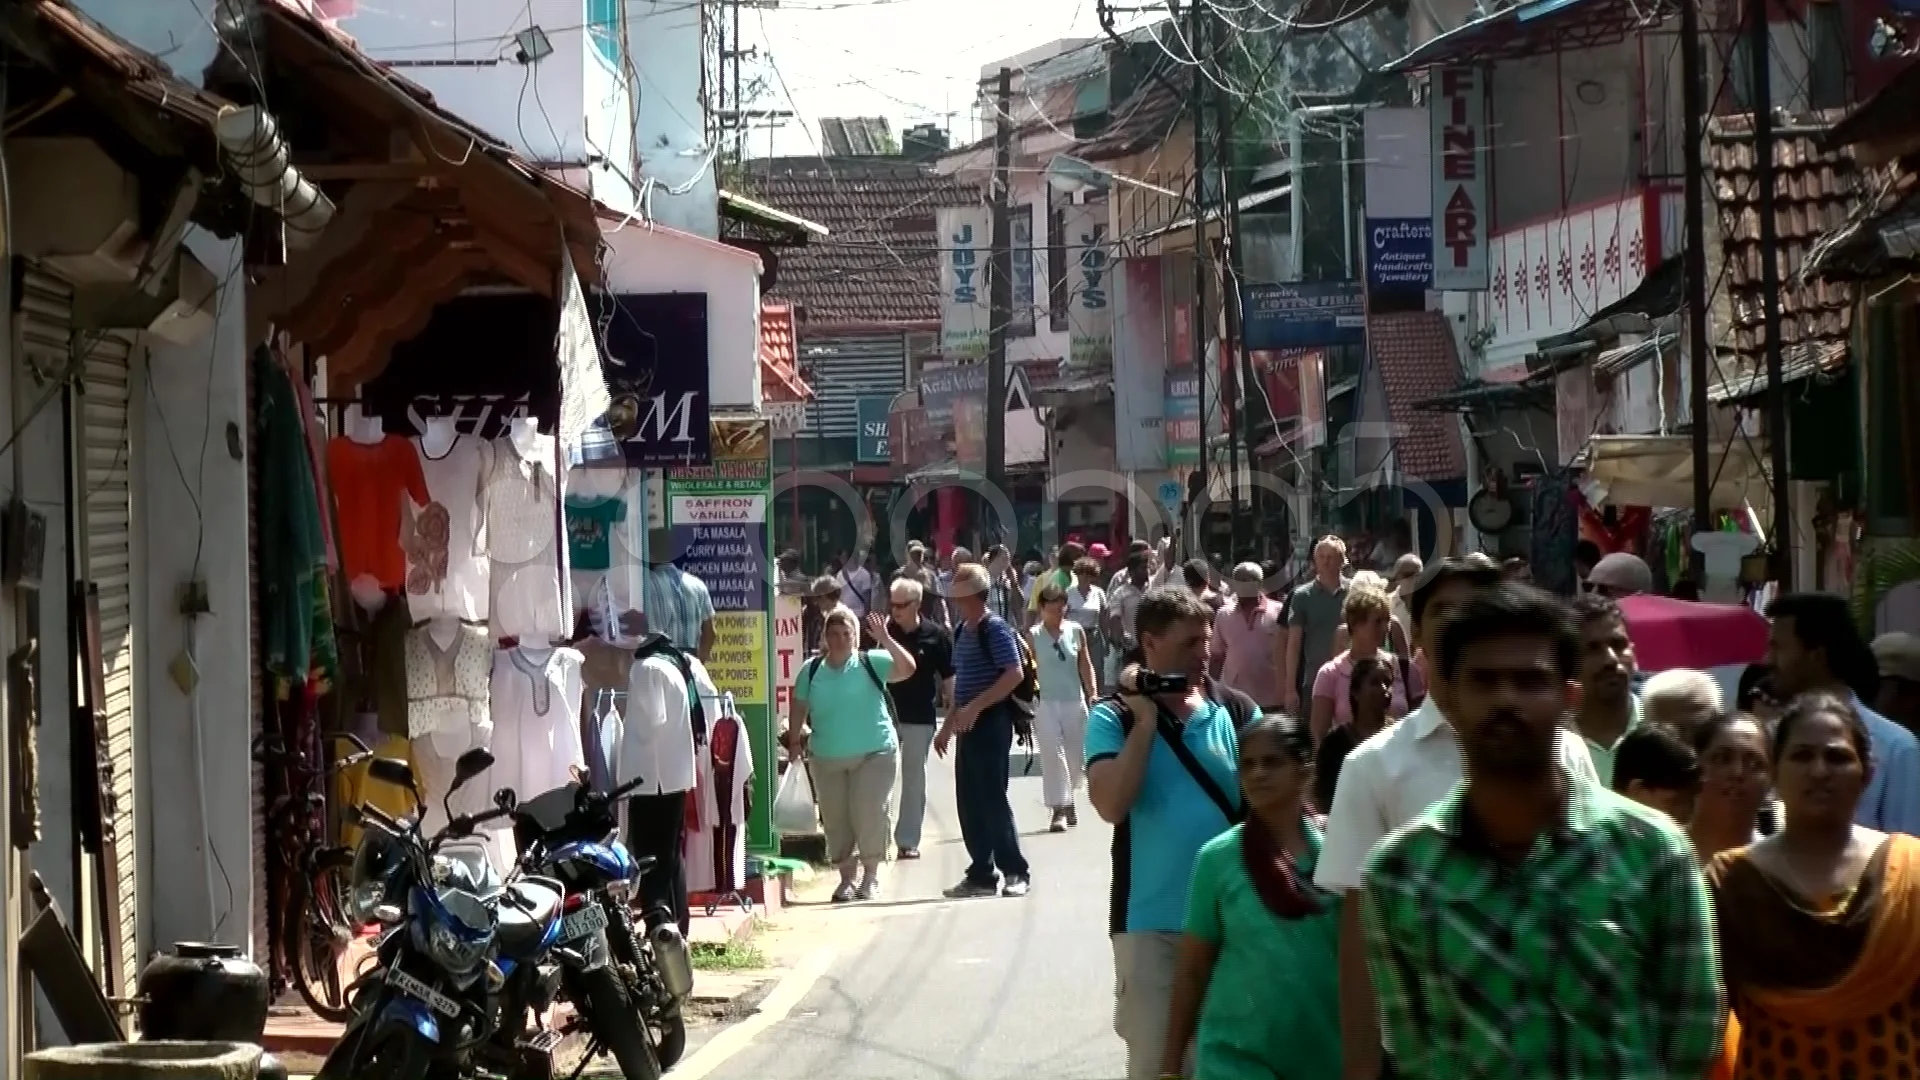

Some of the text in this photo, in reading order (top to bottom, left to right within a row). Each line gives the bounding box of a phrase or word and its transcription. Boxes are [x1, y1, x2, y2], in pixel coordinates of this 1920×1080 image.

[1443, 68, 1476, 181] FINE
[1445, 184, 1477, 267] ART
[1374, 222, 1432, 248] Crafters
[1381, 252, 1426, 261] Antiques
[952, 224, 977, 303] JOYS
[1080, 224, 1106, 309] JOYS
[1374, 262, 1433, 271] Handicrafts
[1379, 272, 1429, 283] Jewellery
[406, 390, 699, 442] SHAM
[671, 480, 763, 490] WHOLESALE & RETAIL
[685, 498, 753, 509] SAFFRON
[689, 510, 749, 520] VANILLA
[693, 526, 747, 539] TEA MASALA
[686, 544, 754, 557] CURRY MASALA
[682, 561, 758, 575] CHICKEN MASALA
[718, 579, 755, 592] MASALA
[712, 597, 749, 609] MASALA
[724, 616, 758, 628] POWDER
[776, 615, 800, 637] IAN
[722, 634, 754, 646] POWDER
[719, 651, 752, 664] POWDER
[726, 668, 758, 681] POWDER
